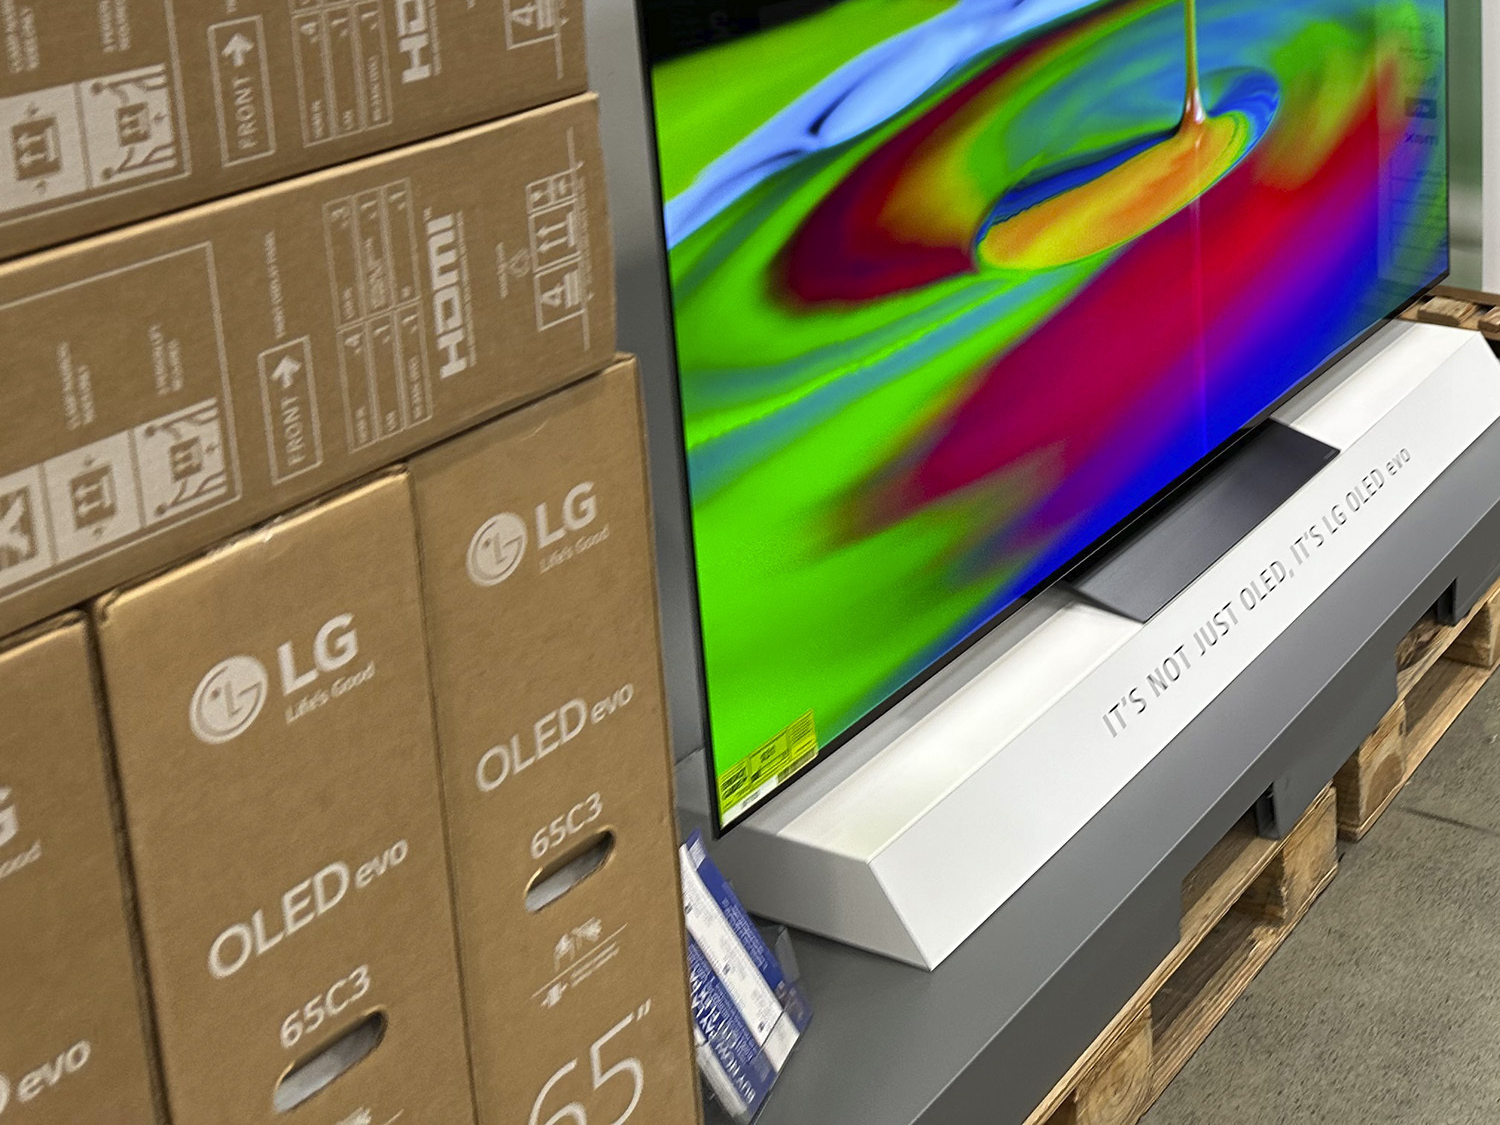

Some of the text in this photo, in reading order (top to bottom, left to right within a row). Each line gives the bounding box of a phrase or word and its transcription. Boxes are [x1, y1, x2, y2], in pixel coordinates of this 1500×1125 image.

[231, 77, 259, 149] FRONT
[424, 213, 468, 378] HDMI
[280, 396, 306, 467] FRONT
[535, 481, 597, 549] LG
[1101, 447, 1412, 738] IT'S NOT JUST OLED, IT'S LG OLED evo
[276, 612, 360, 696] LG
[475, 682, 635, 793] OLED evo
[530, 791, 604, 859] 65C3
[207, 838, 410, 979] OLED evo
[279, 964, 373, 1048] 65C3
[17, 1038, 92, 1106] evo
